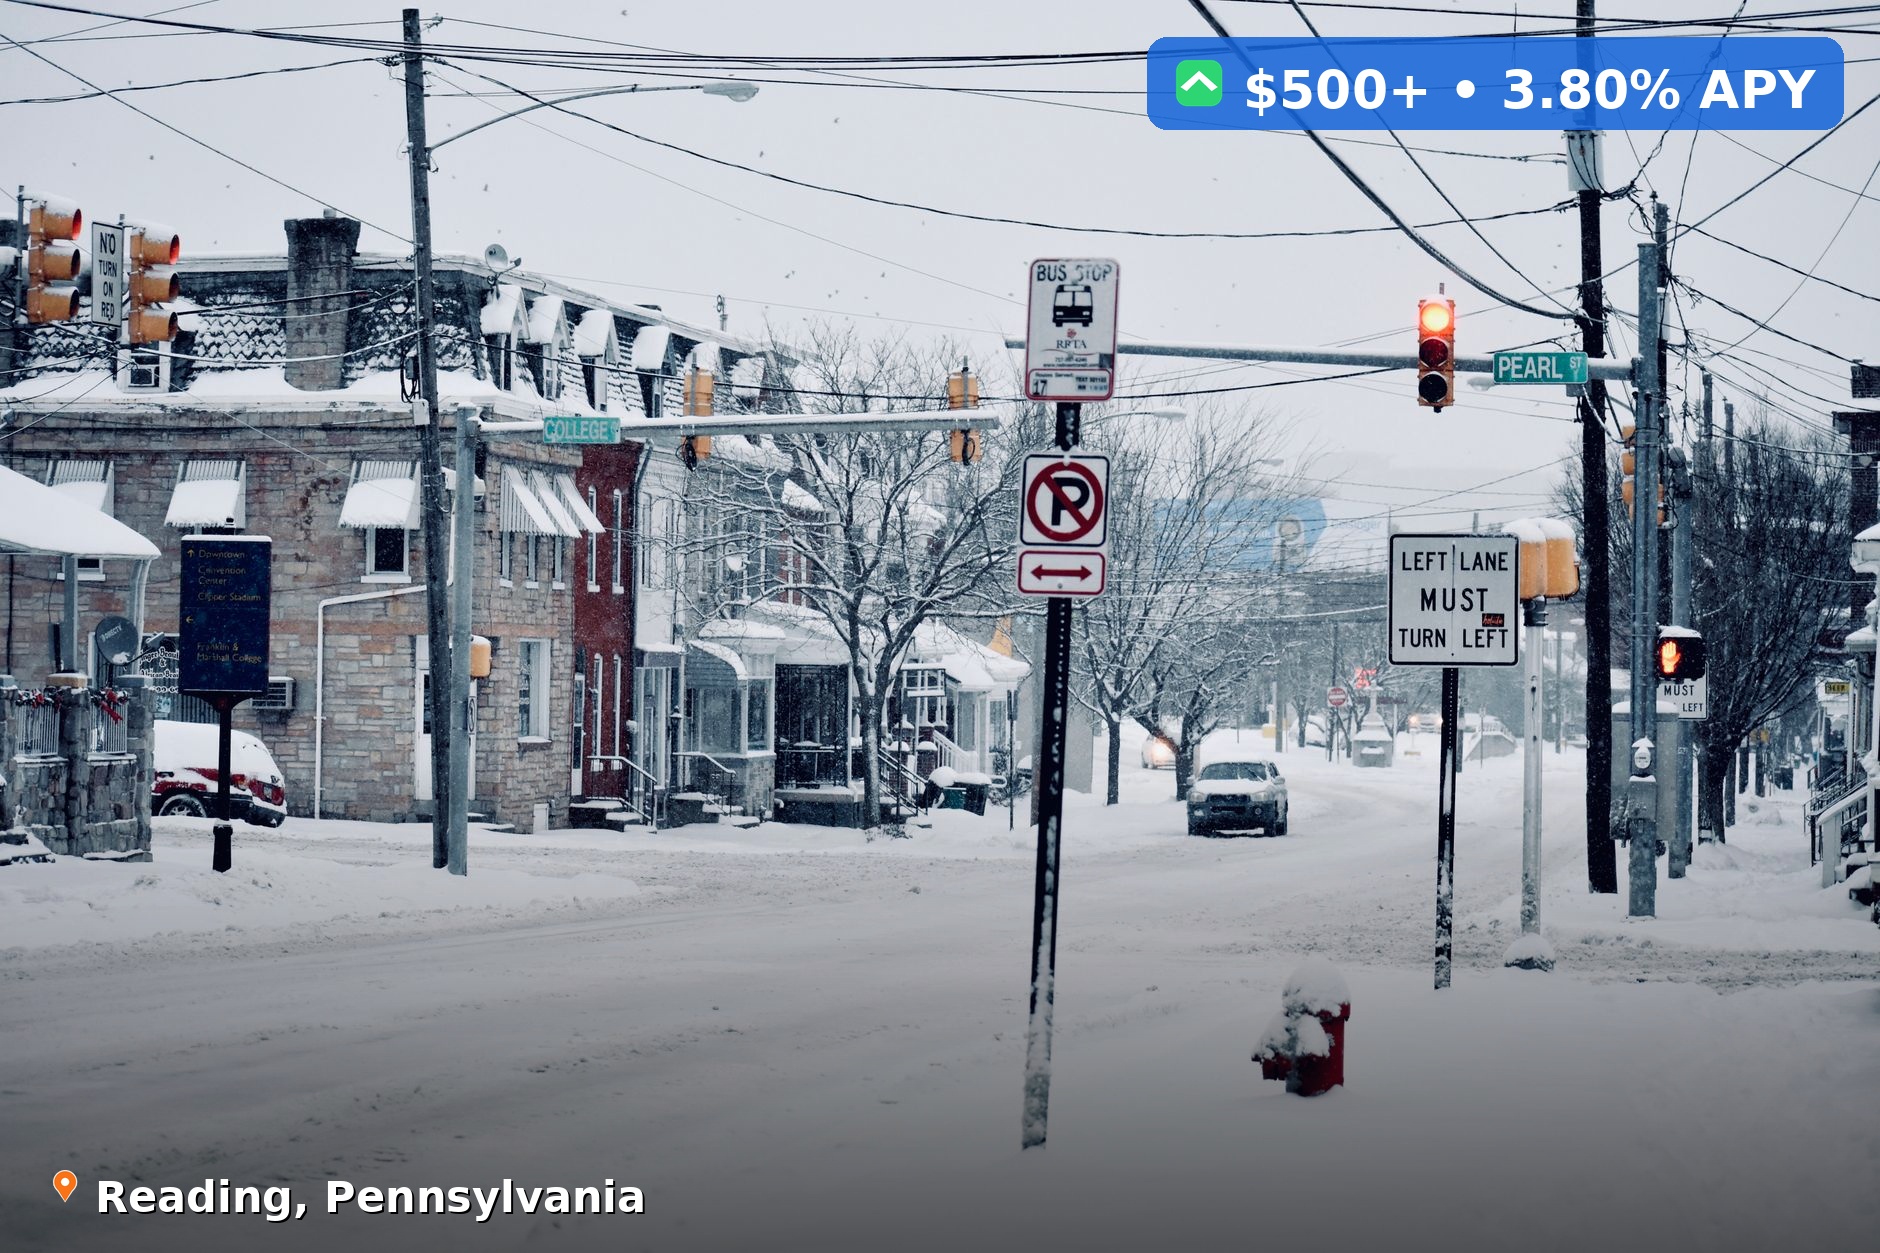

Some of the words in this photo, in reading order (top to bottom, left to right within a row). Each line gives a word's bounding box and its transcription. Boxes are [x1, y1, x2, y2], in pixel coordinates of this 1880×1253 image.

[100, 231, 116, 255] NO
[98, 259, 117, 278] TURN
[1037, 264, 1067, 282] BUS
[1075, 264, 1112, 282] STOP
[103, 281, 114, 298] ON
[101, 301, 115, 319] RED
[1498, 356, 1563, 379] PEARL
[1569, 356, 1582, 369] ST
[1033, 380, 1047, 396] 17
[545, 420, 608, 440] COLLEGE
[198, 549, 245, 559] Downtown
[1402, 551, 1447, 571] LEFT
[1460, 551, 1508, 571] LANE
[198, 565, 246, 575] Convention
[198, 576, 227, 585] Center
[1420, 587, 1488, 612] MUST
[232, 642, 239, 651] &
[1399, 628, 1446, 648] TURN
[1463, 628, 1508, 648] LEFT
[1664, 684, 1695, 696] MUST
[1682, 702, 1703, 712] LEFT
